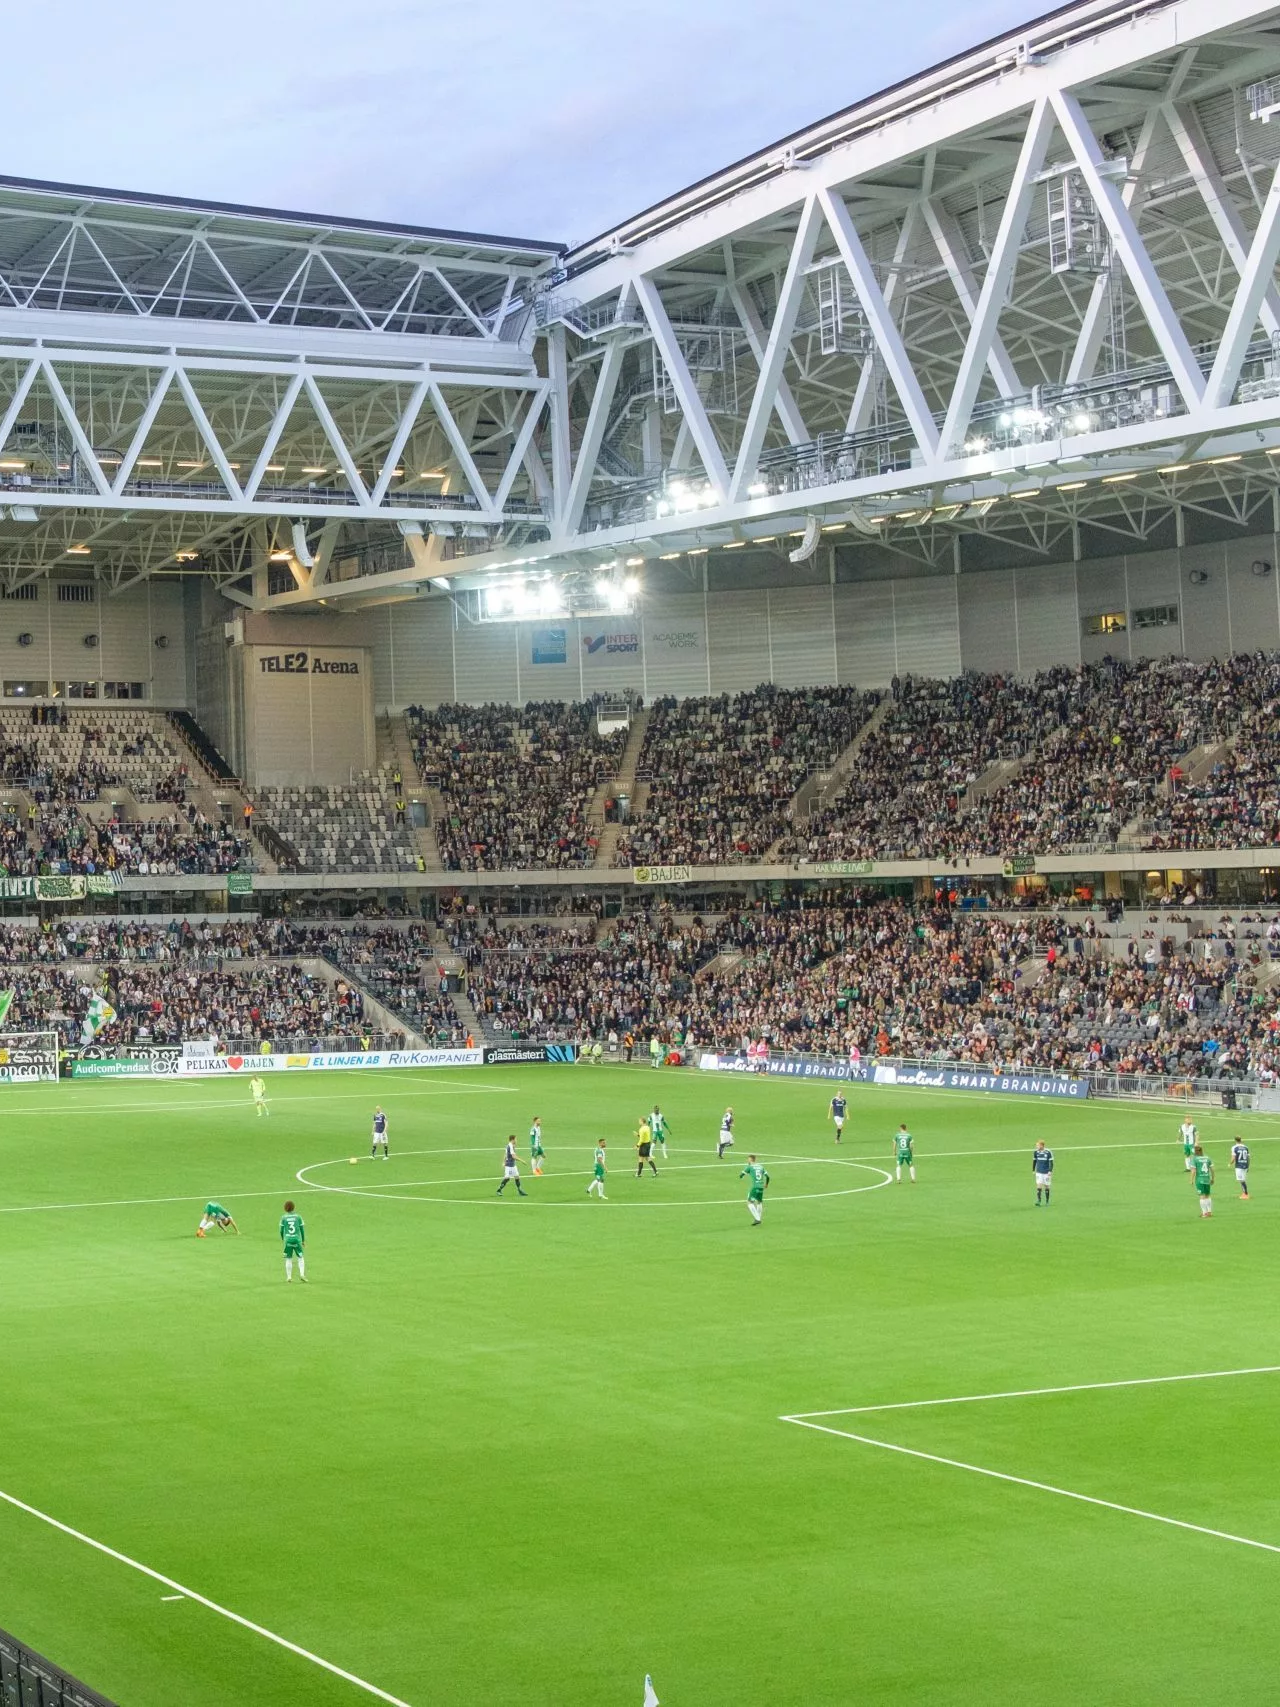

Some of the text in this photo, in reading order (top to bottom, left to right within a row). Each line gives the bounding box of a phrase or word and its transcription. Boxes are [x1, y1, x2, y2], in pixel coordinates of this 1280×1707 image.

[606, 634, 637, 644] INTER
[652, 632, 699, 642] ACADEMIC
[606, 643, 639, 653] SPORT
[260, 651, 359, 674] TELE2 Arena
[650, 866, 690, 881] BAJEN
[313, 1055, 380, 1066] EL LINJEN AB
[488, 1049, 545, 1063] glasmästeri
[75, 1062, 150, 1074] AudicomPendax
[186, 1057, 275, 1070] PELIKAN BAJEN
[951, 1074, 997, 1089] SMART
[1001, 1078, 1078, 1095] BRANDING
[900, 1138, 907, 1149] 8
[1201, 1162, 1209, 1174] 4
[287, 1221, 296, 1234] 3
